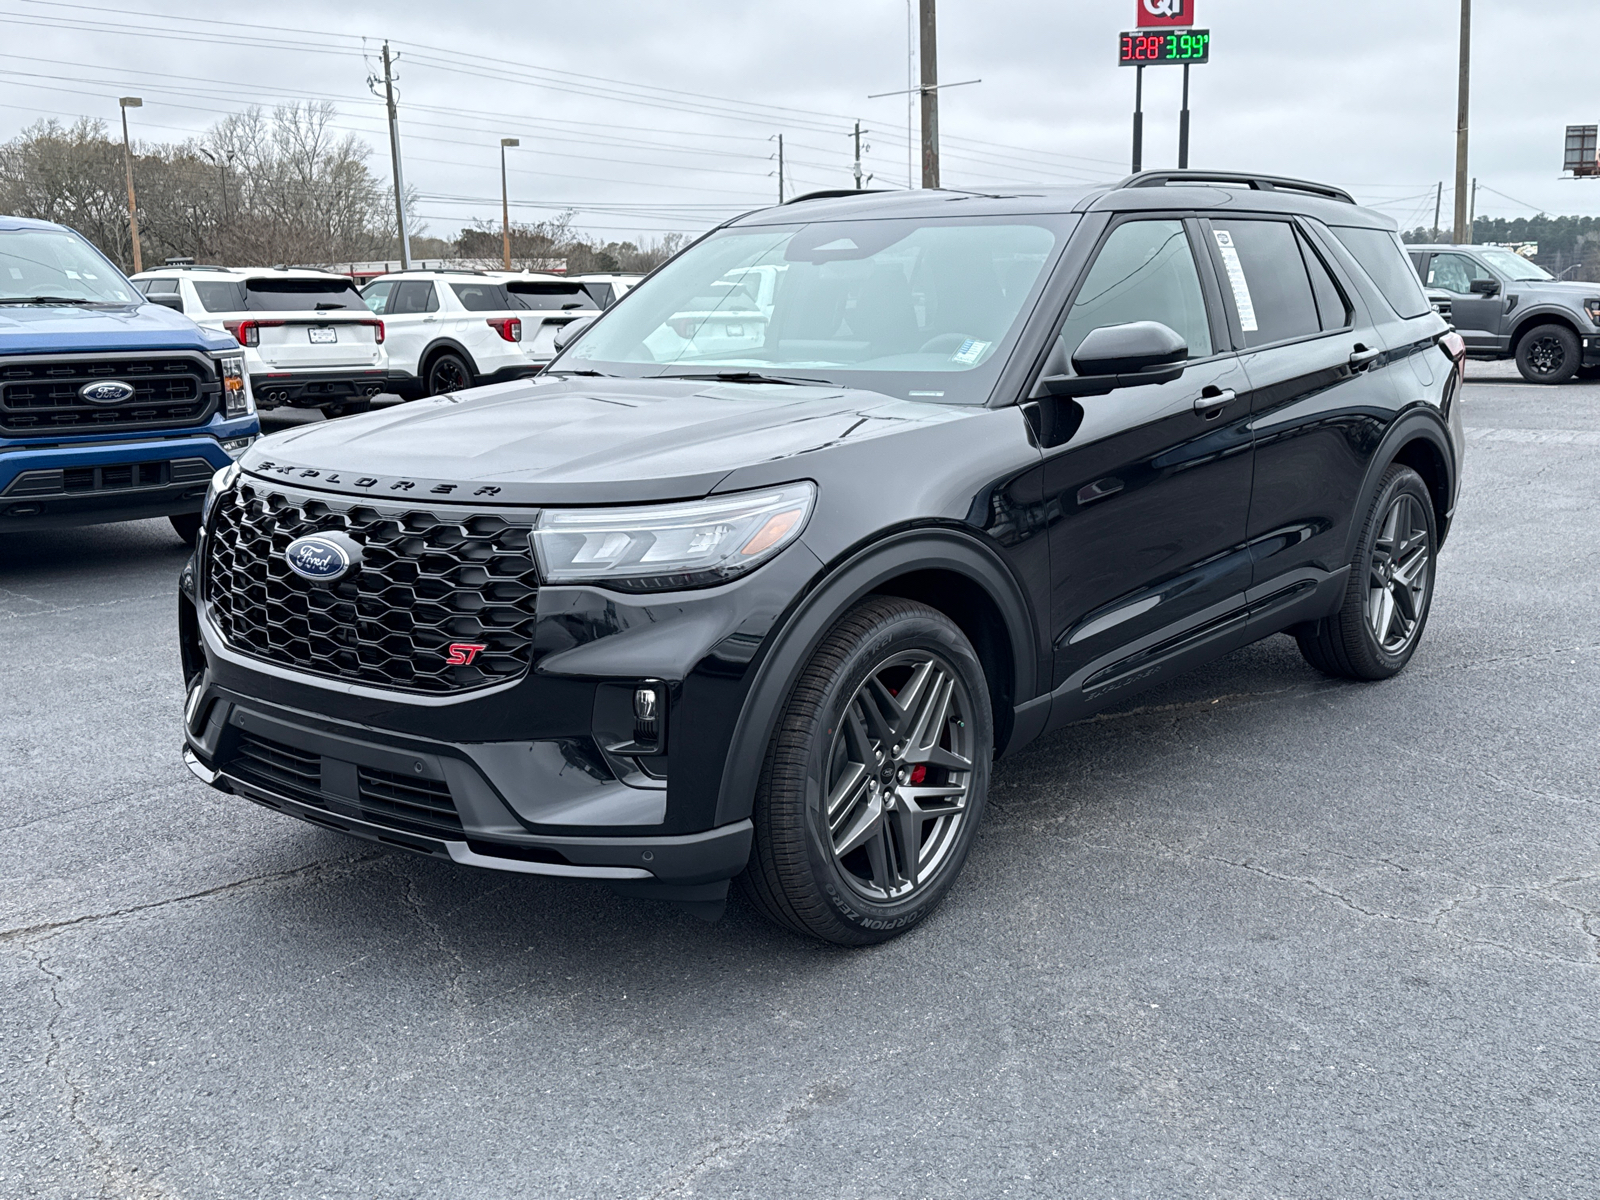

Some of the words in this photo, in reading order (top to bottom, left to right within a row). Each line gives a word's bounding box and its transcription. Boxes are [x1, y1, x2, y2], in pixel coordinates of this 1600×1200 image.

[95, 386, 123, 399] Ford
[257, 460, 502, 497] EXPLORER
[296, 544, 332, 571] Ford
[446, 643, 488, 666] ST
[825, 883, 860, 921] ZERO
